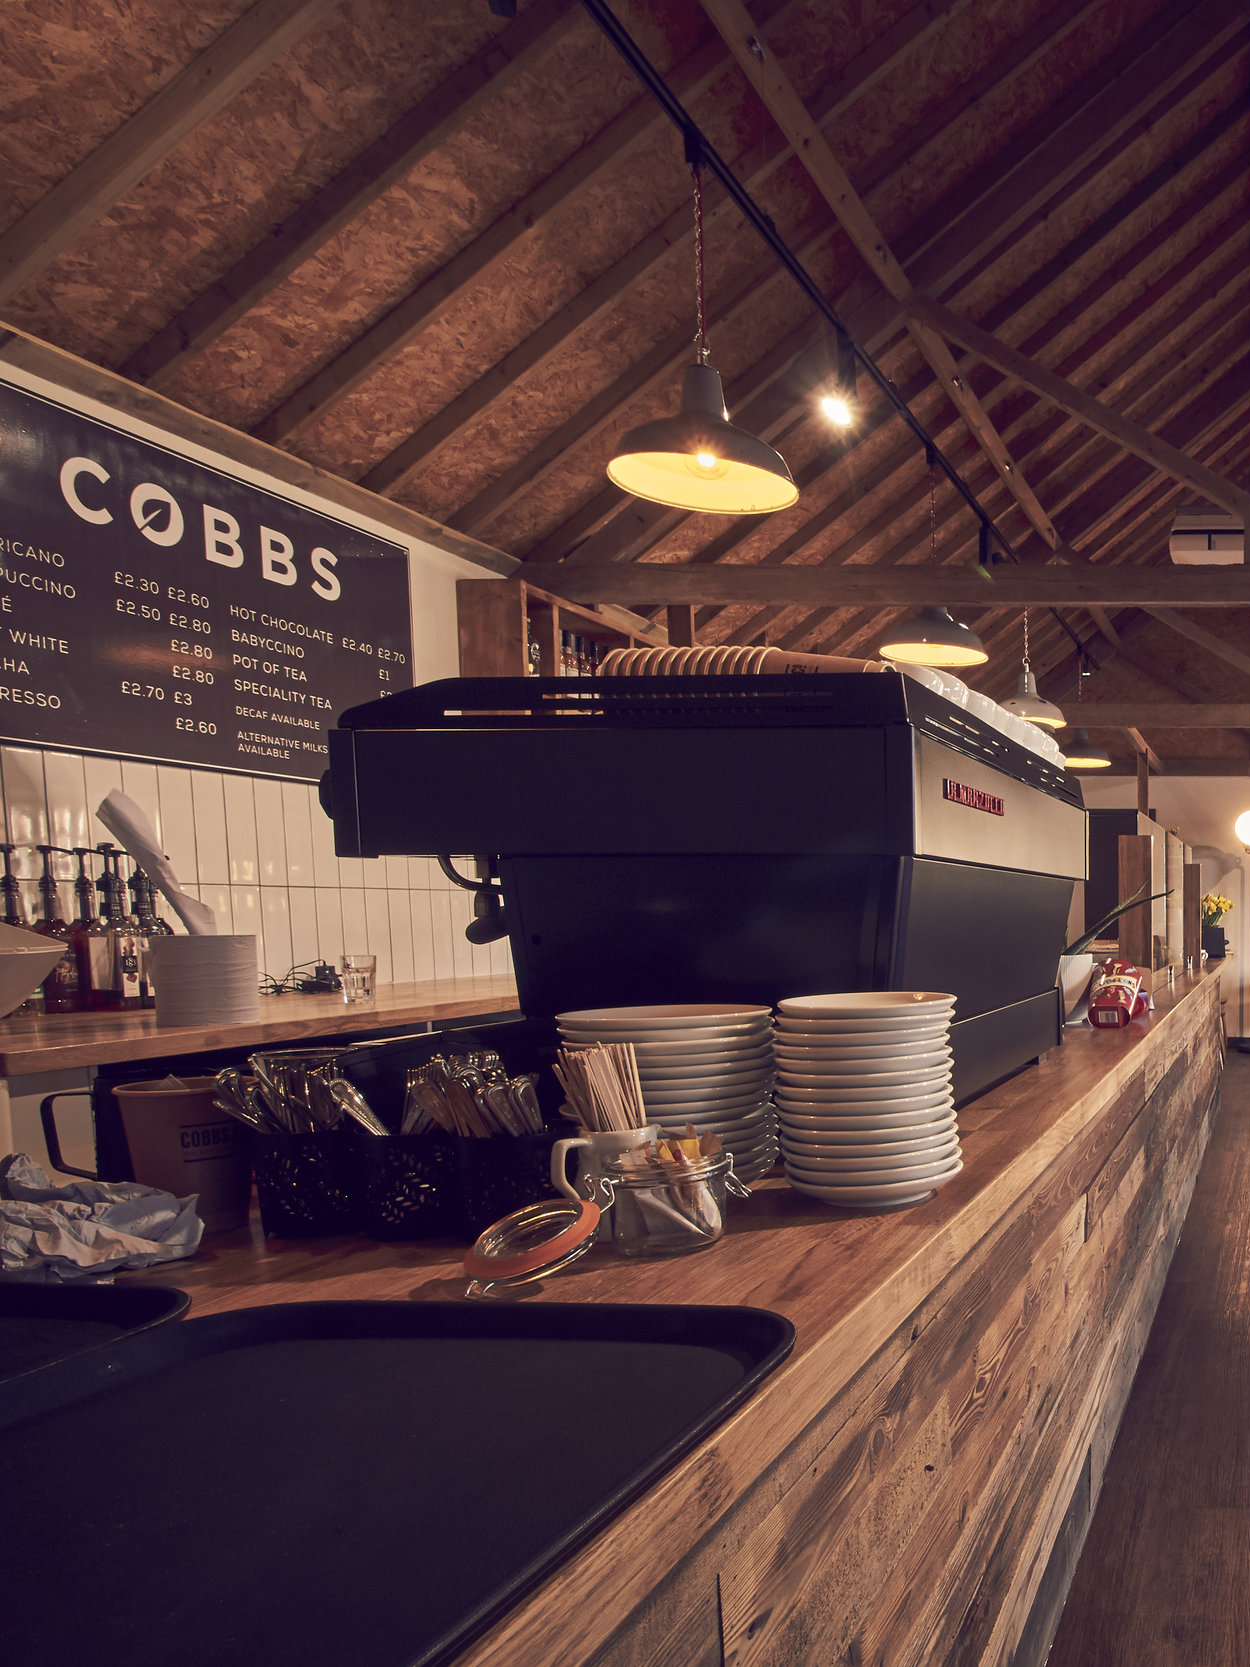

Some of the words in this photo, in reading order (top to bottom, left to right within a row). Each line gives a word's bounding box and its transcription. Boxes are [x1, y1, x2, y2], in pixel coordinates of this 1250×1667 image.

[60, 456, 342, 601] COBBS
[114, 571, 160, 595] £2.30
[167, 586, 210, 609] £2.60
[116, 598, 161, 621] £2.50
[169, 612, 211, 634] £2.80
[230, 604, 257, 622] HOT
[260, 613, 334, 645] CHOCOLATE
[342, 637, 373, 655] £2.40
[377, 647, 406, 664] £2.70
[9, 628, 69, 655] WHITE
[172, 665, 214, 685] £2.80
[171, 639, 213, 660] £2.80
[231, 629, 305, 659] BABYCCINO
[379, 668, 390, 681] £1
[232, 653, 259, 670] POT
[262, 661, 280, 675] OF
[283, 666, 308, 682] TEA
[0, 657, 30, 675] HA
[121, 680, 165, 701] £2.70
[174, 691, 193, 706] £3
[234, 678, 306, 704] SPECIALITY
[309, 695, 333, 711] TEA
[0, 686, 61, 709] RESSO
[176, 717, 217, 735] £2.60
[235, 705, 268, 720] DECAF
[271, 713, 321, 731] AVAILABLE
[237, 730, 300, 750] ALTERNATIVE
[302, 741, 329, 754] MILKS
[238, 743, 291, 760] AVAILABLE
[180, 1127, 230, 1149] COBBS
